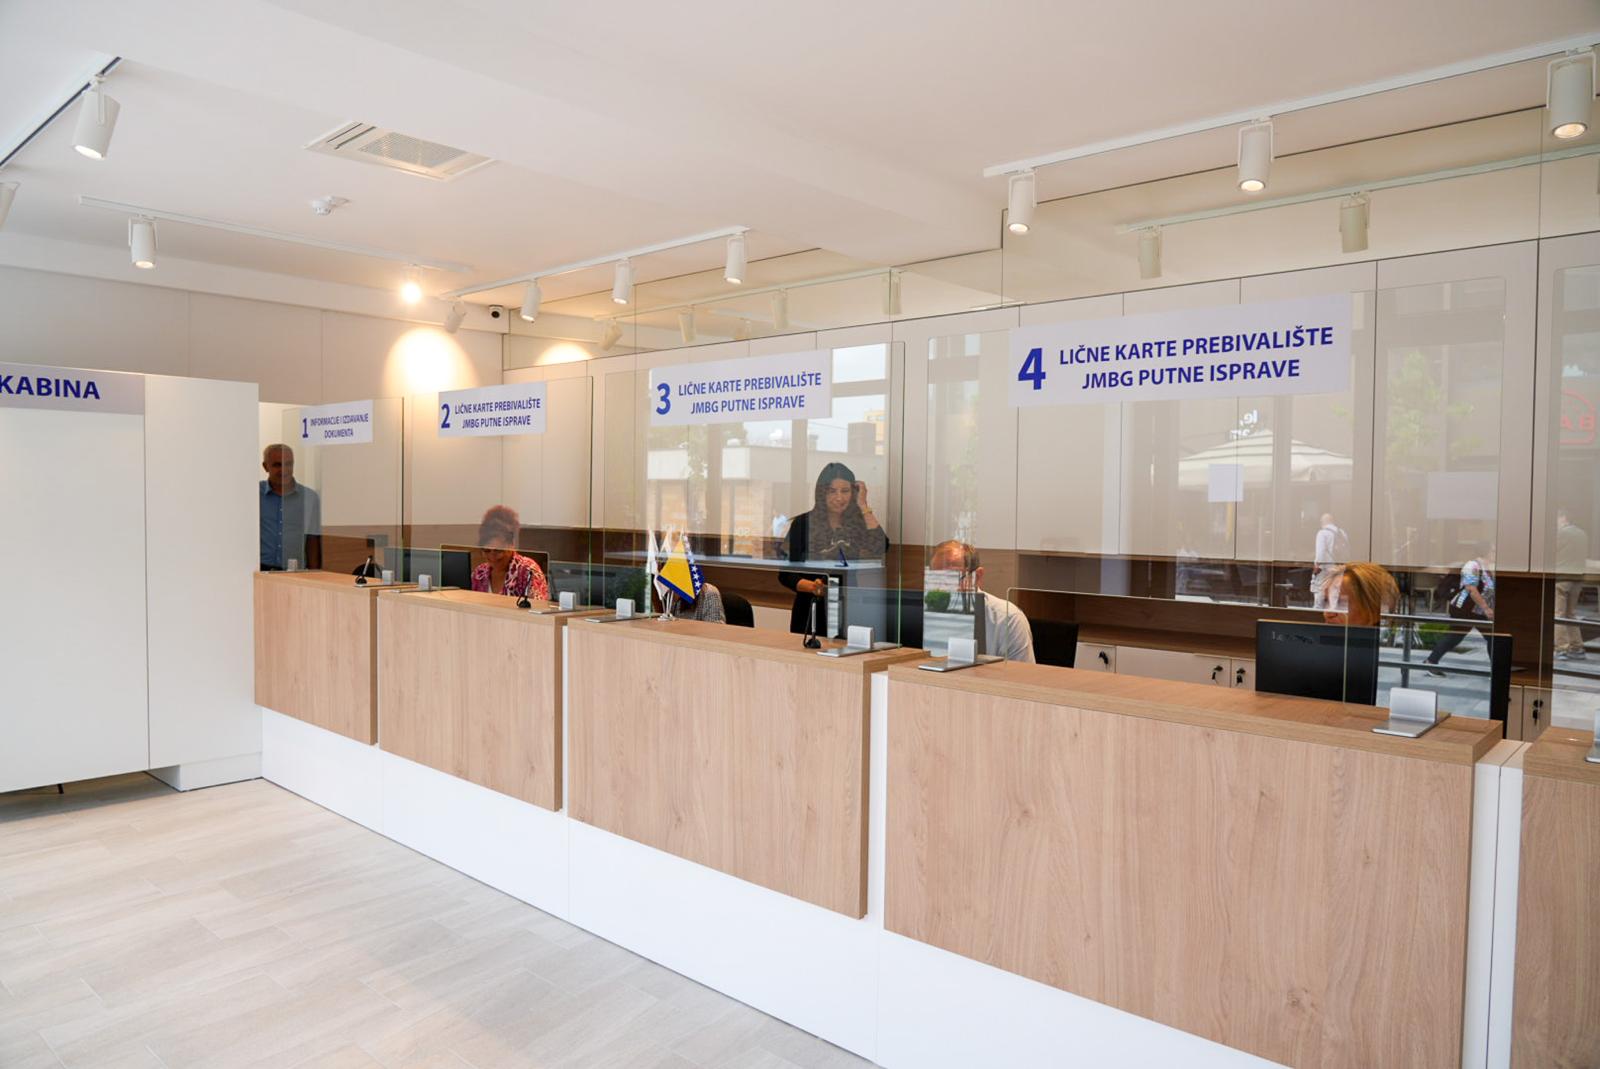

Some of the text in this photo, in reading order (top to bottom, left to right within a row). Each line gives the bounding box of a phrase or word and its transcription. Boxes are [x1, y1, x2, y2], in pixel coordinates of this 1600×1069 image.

[1060, 325, 1334, 365] LIČNE KARTE PREBIVALIŠTE
[1018, 347, 1046, 390] 4
[1082, 359, 1300, 389] JMBG PUTNE ISPRAVE
[0, 375, 100, 400] KABINA
[678, 371, 822, 396] LIČNE KARTE PREBIVALIŠTE
[455, 397, 541, 414] LIČNE KARTE PREBIVALIŠTE
[656, 382, 671, 415] 3
[691, 395, 805, 415] JMBG PUTNE ISPRAVE
[302, 418, 309, 438] 1
[441, 403, 450, 428] 2
[462, 415, 531, 429] JMBG PUTNE ISPRAVE
